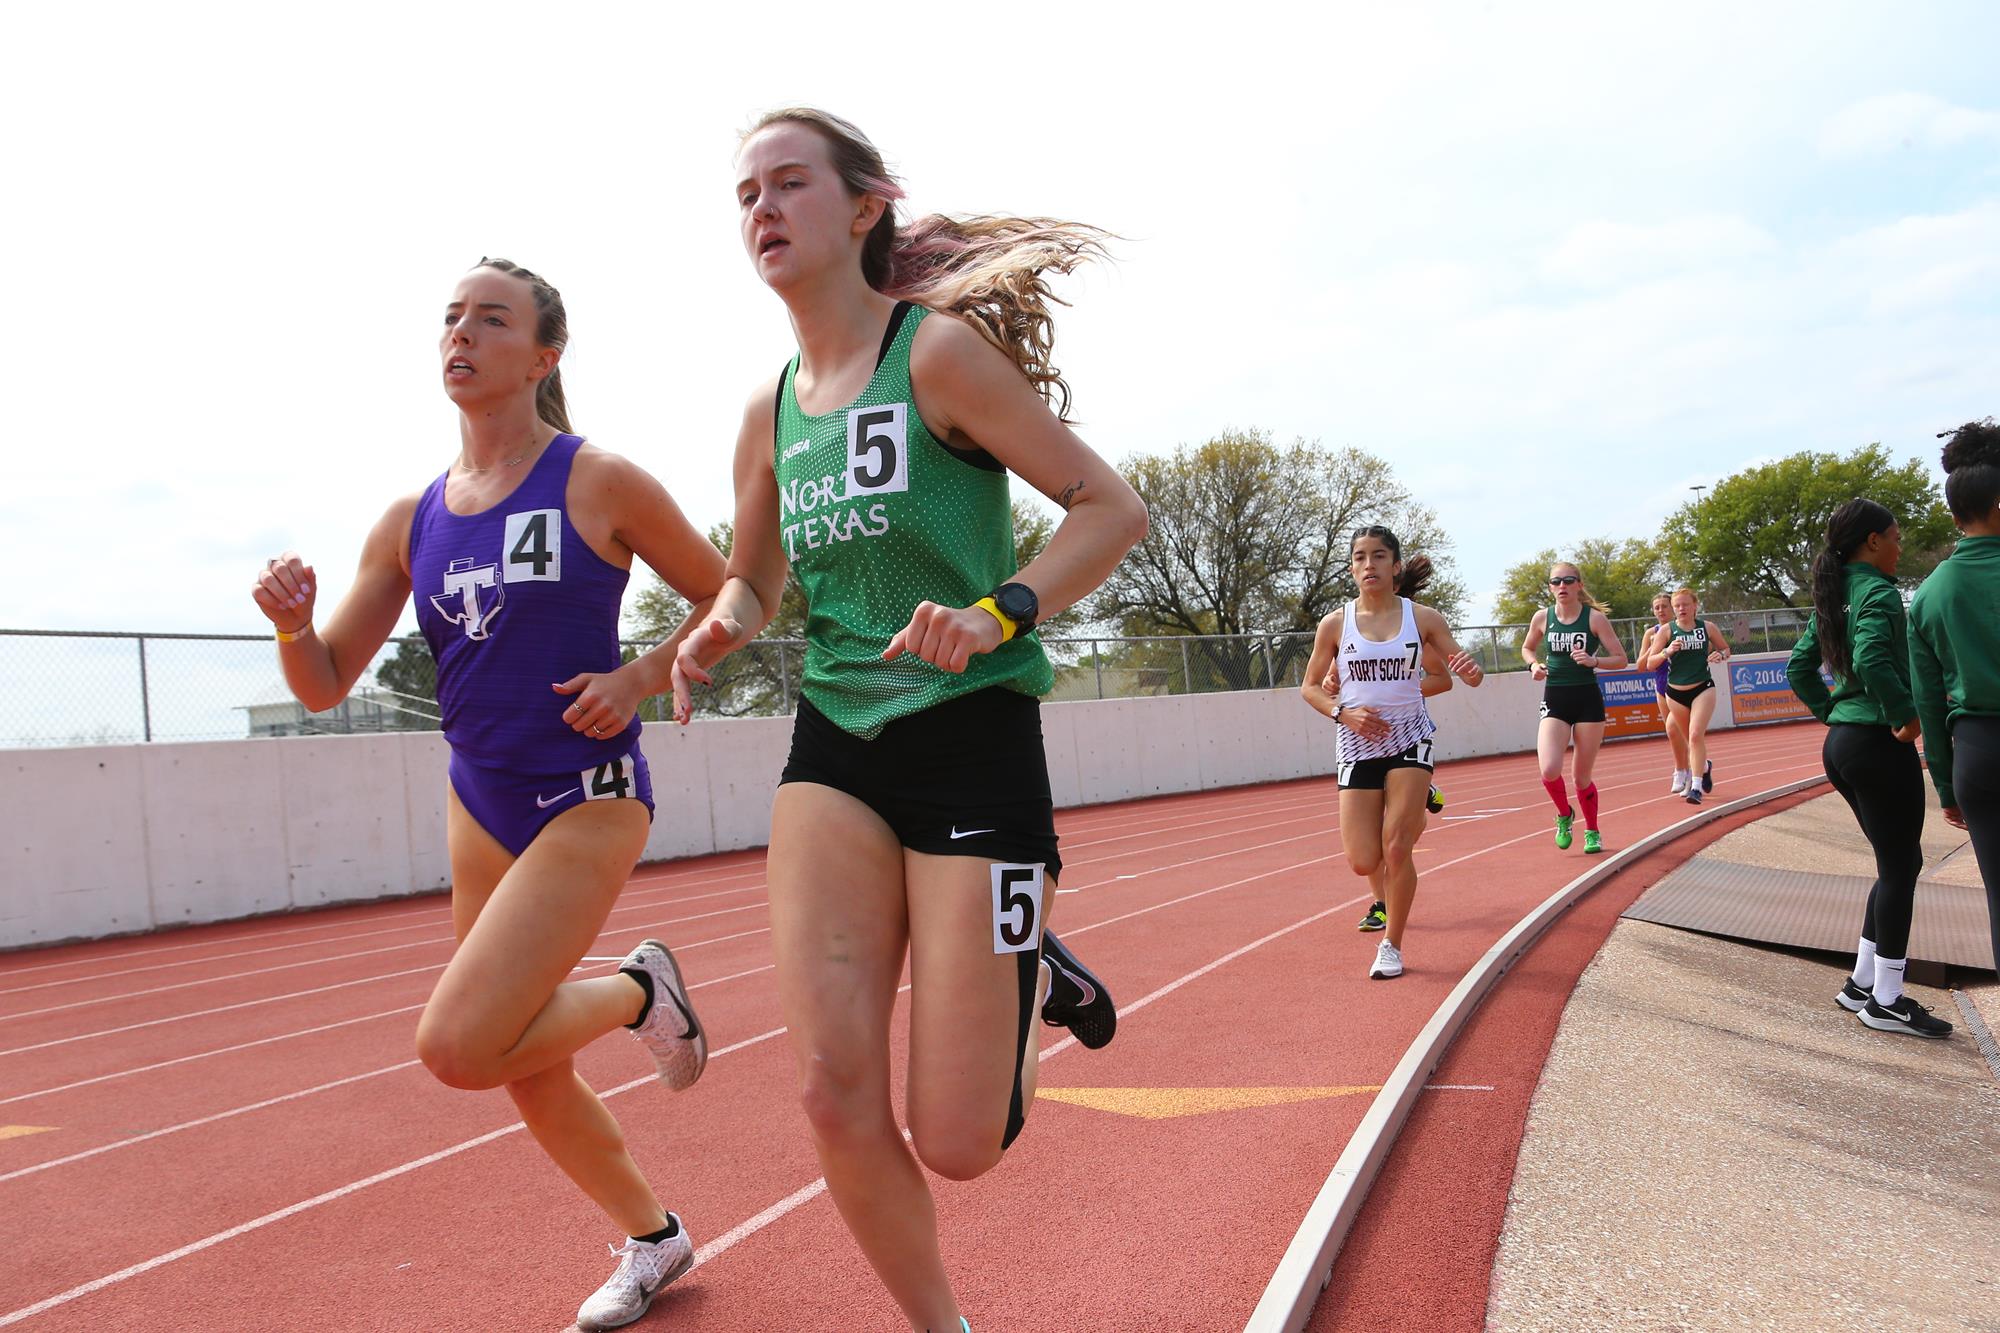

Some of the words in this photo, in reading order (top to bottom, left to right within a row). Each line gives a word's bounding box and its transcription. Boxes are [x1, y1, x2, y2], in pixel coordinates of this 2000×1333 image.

[854, 410, 896, 488] 5
[780, 471, 850, 522] NORT
[783, 503, 889, 562] TEXAS
[510, 514, 553, 576] 4
[1548, 632, 1571, 643] OKLAH
[1573, 633, 1584, 650] 6
[1695, 629, 1704, 640] 8
[1405, 642, 1418, 669] 7
[1551, 643, 1571, 652] BAPT
[1348, 659, 1378, 681] FORT
[1755, 669, 1787, 685] 2016-
[1605, 680, 1645, 694] NATIONAL
[1646, 678, 1656, 691] CH
[1421, 739, 1432, 762] 7
[592, 758, 630, 798] 4
[1000, 868, 1035, 946] 5
